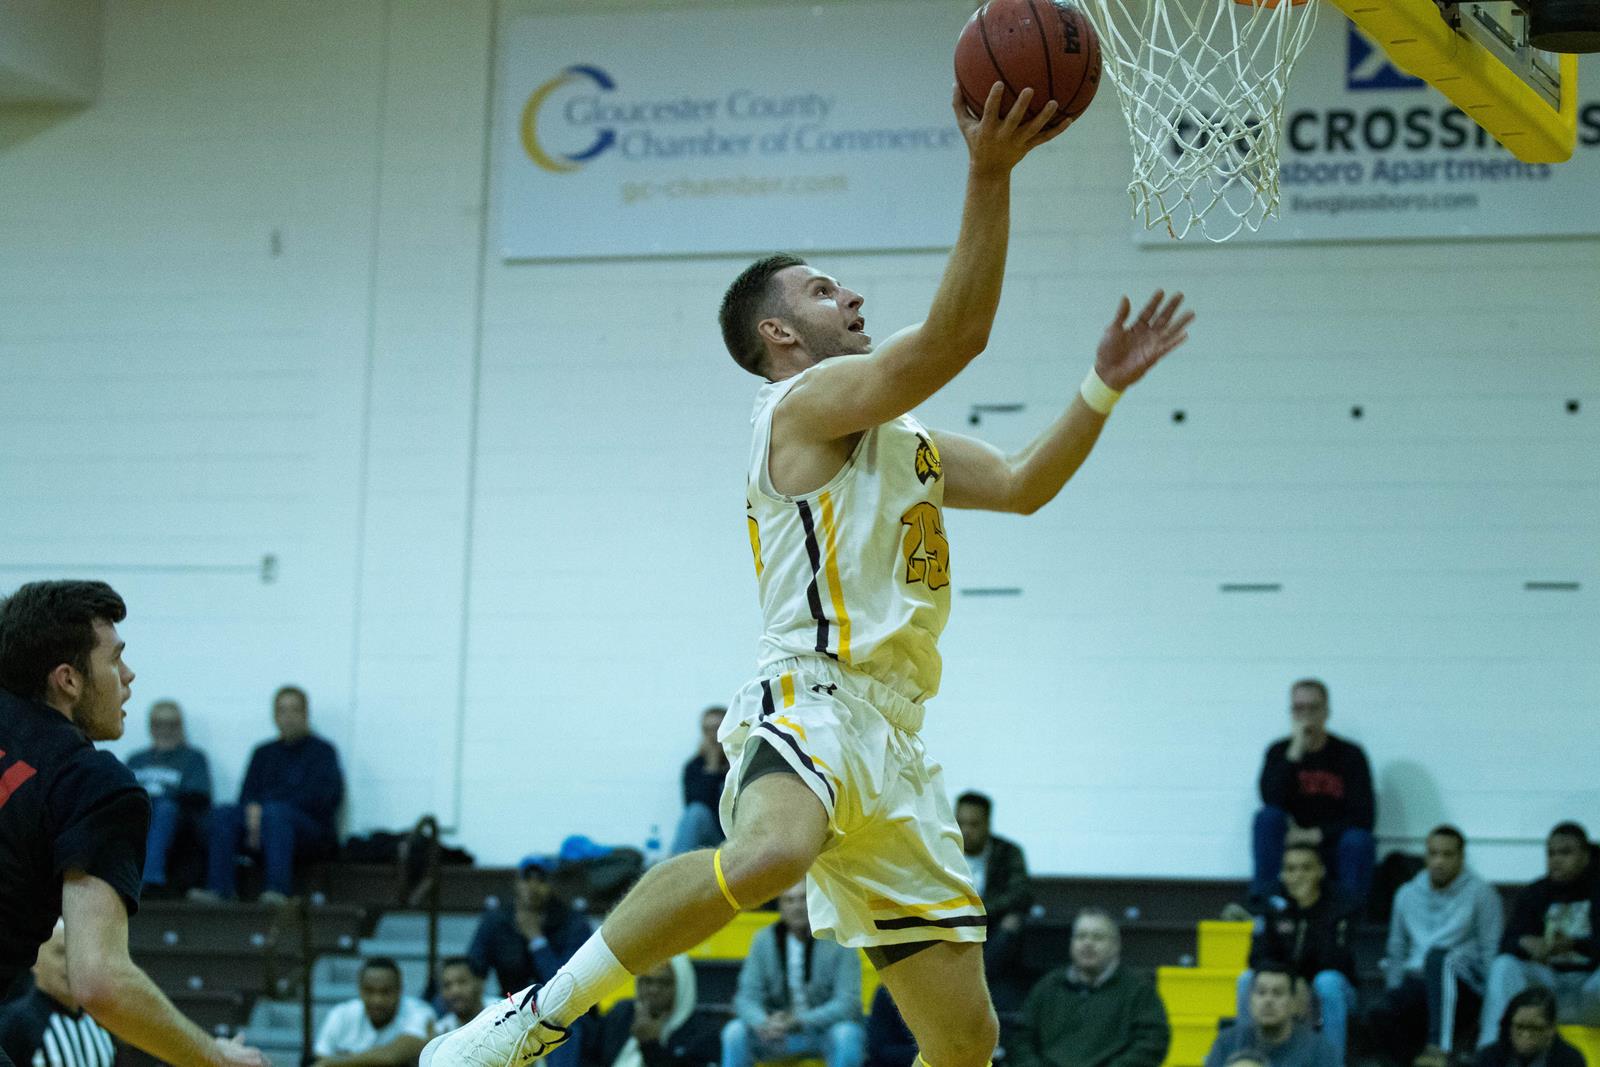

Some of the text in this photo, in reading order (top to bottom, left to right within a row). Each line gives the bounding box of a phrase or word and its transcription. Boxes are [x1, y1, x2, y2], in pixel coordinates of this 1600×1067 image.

[563, 88, 834, 126] Gloucester County
[619, 124, 957, 161] Chamber of Commerce
[1371, 157, 1552, 185] Apartments
